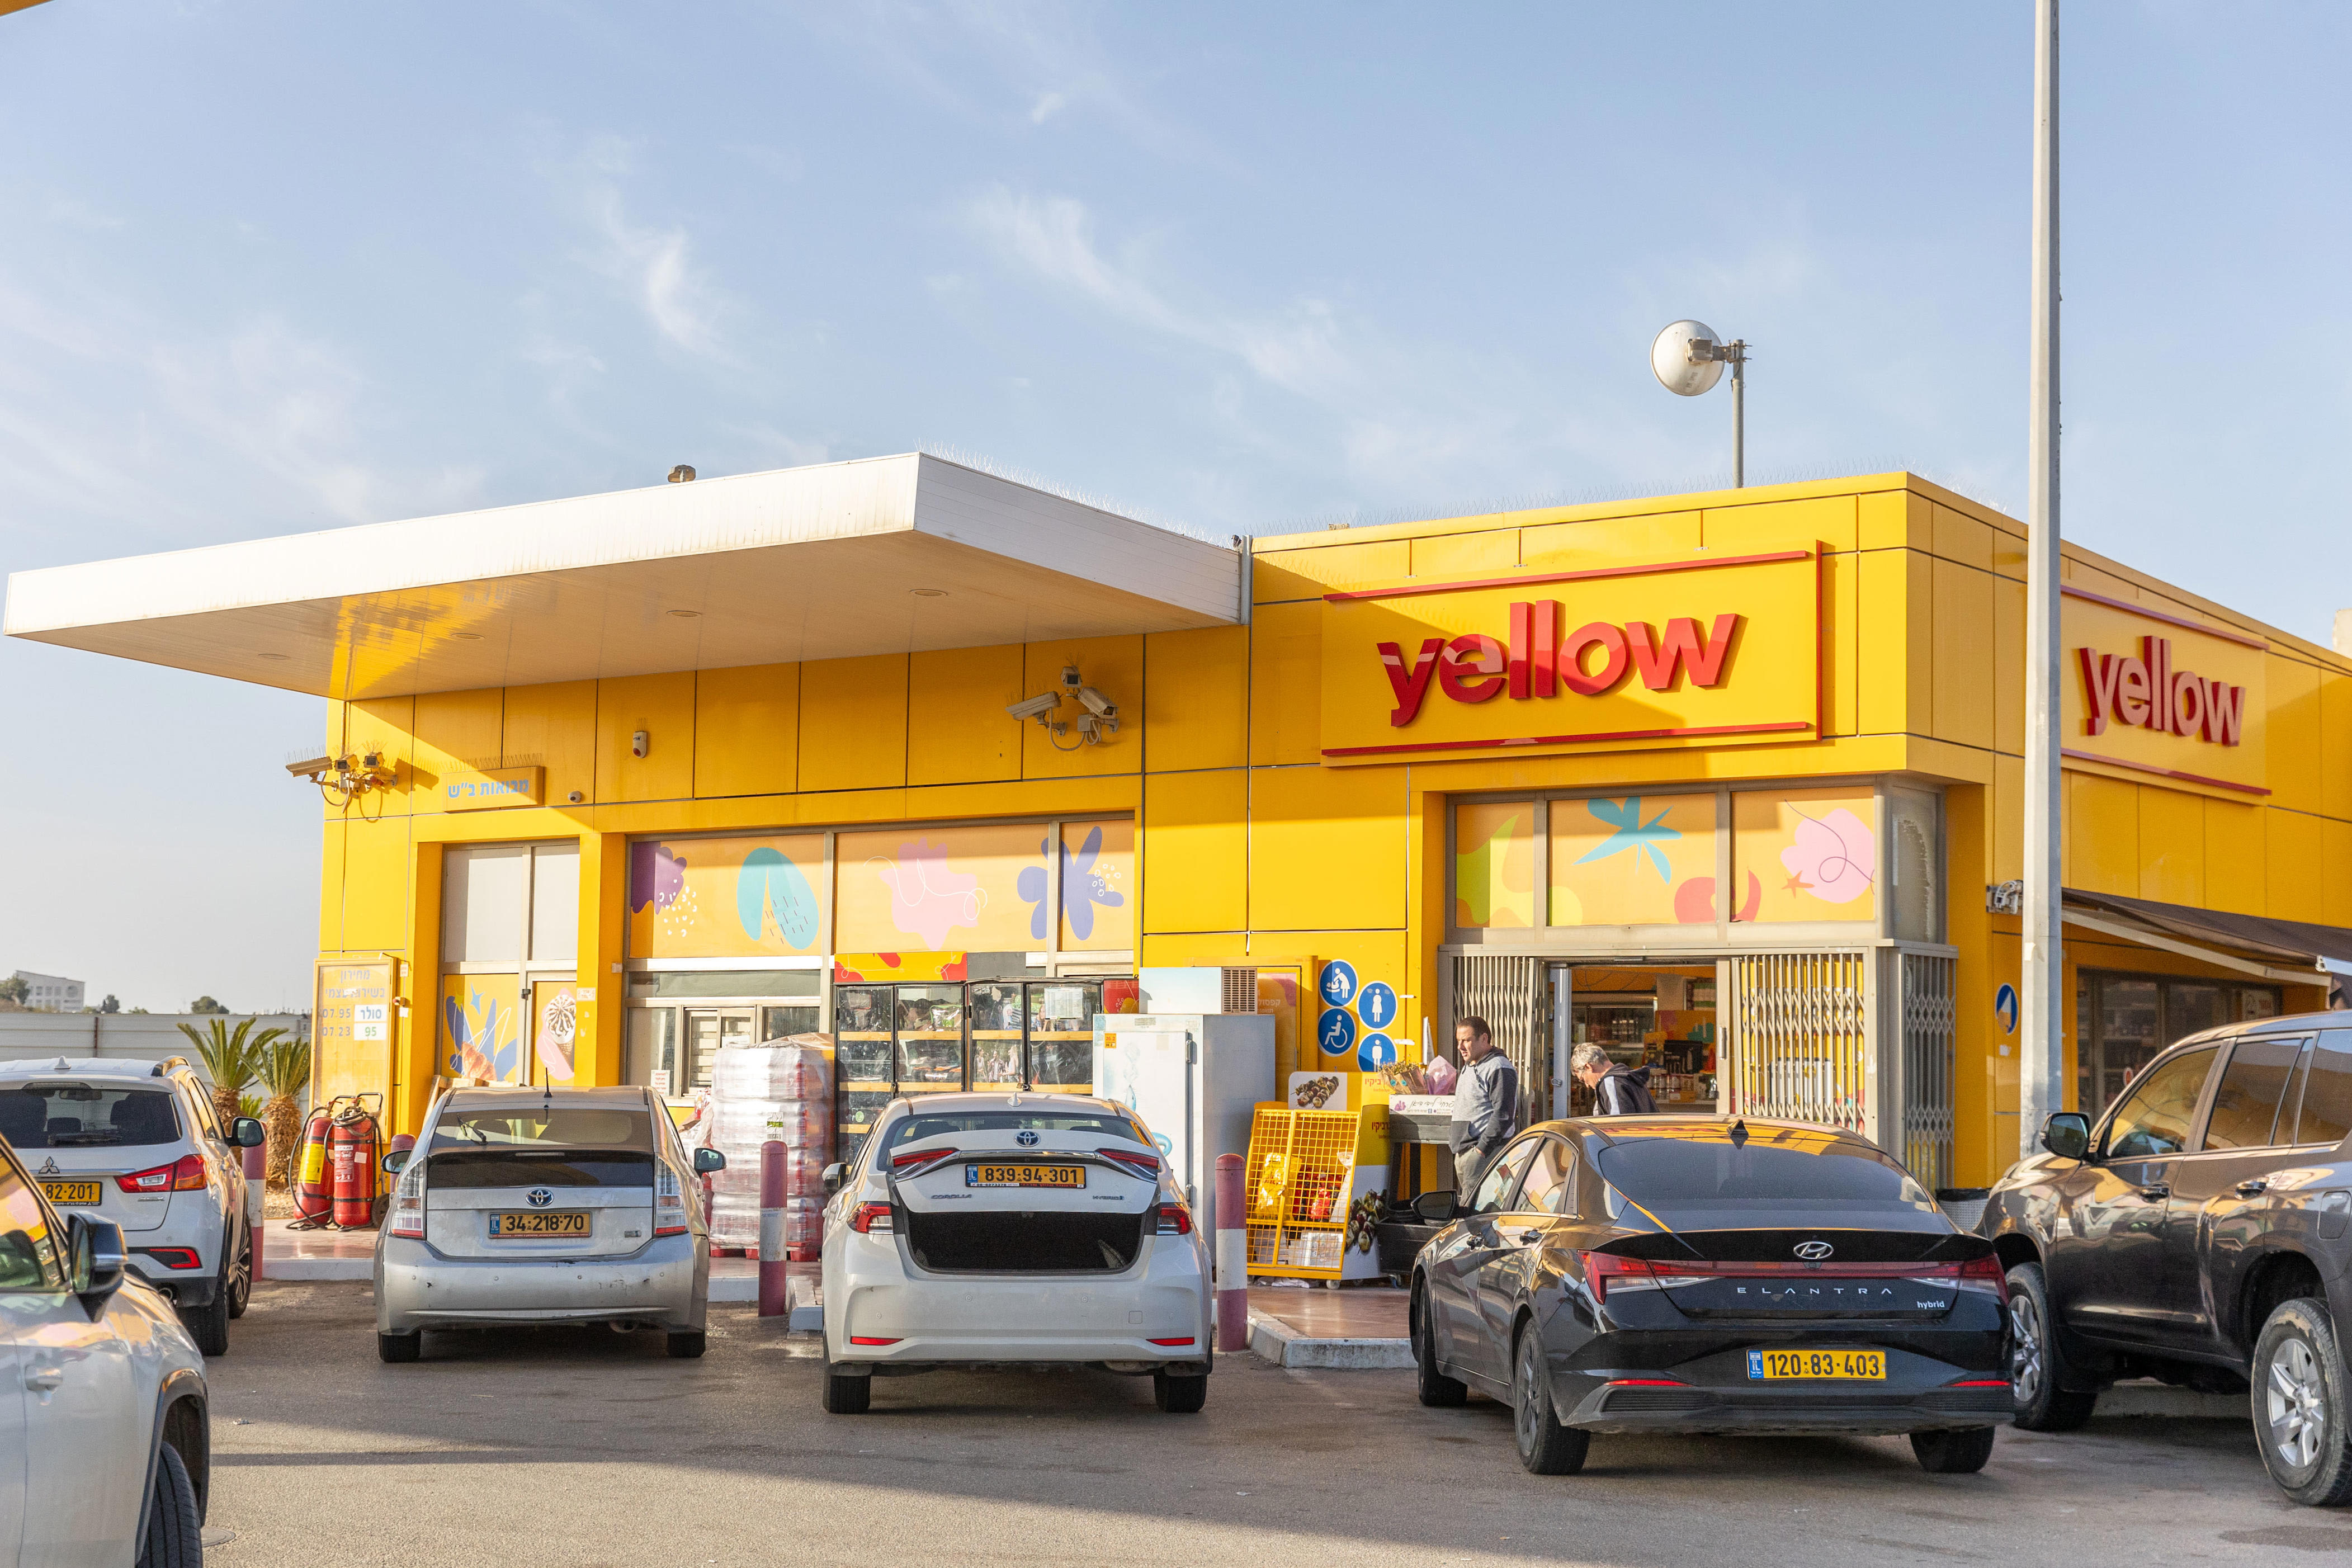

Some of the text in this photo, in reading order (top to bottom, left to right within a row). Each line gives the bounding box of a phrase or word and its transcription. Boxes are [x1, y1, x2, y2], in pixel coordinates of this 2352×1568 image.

[1377, 599, 1738, 728] yellow
[2080, 635, 2246, 747] yellow
[480, 779, 528, 796] מבואות
[341, 970, 370, 983] מחירון
[360, 1006, 382, 1019] סולר
[365, 1026, 377, 1037] 95
[1917, 1300, 1945, 1309] hybrid
[1752, 1359, 1761, 1371] IL
